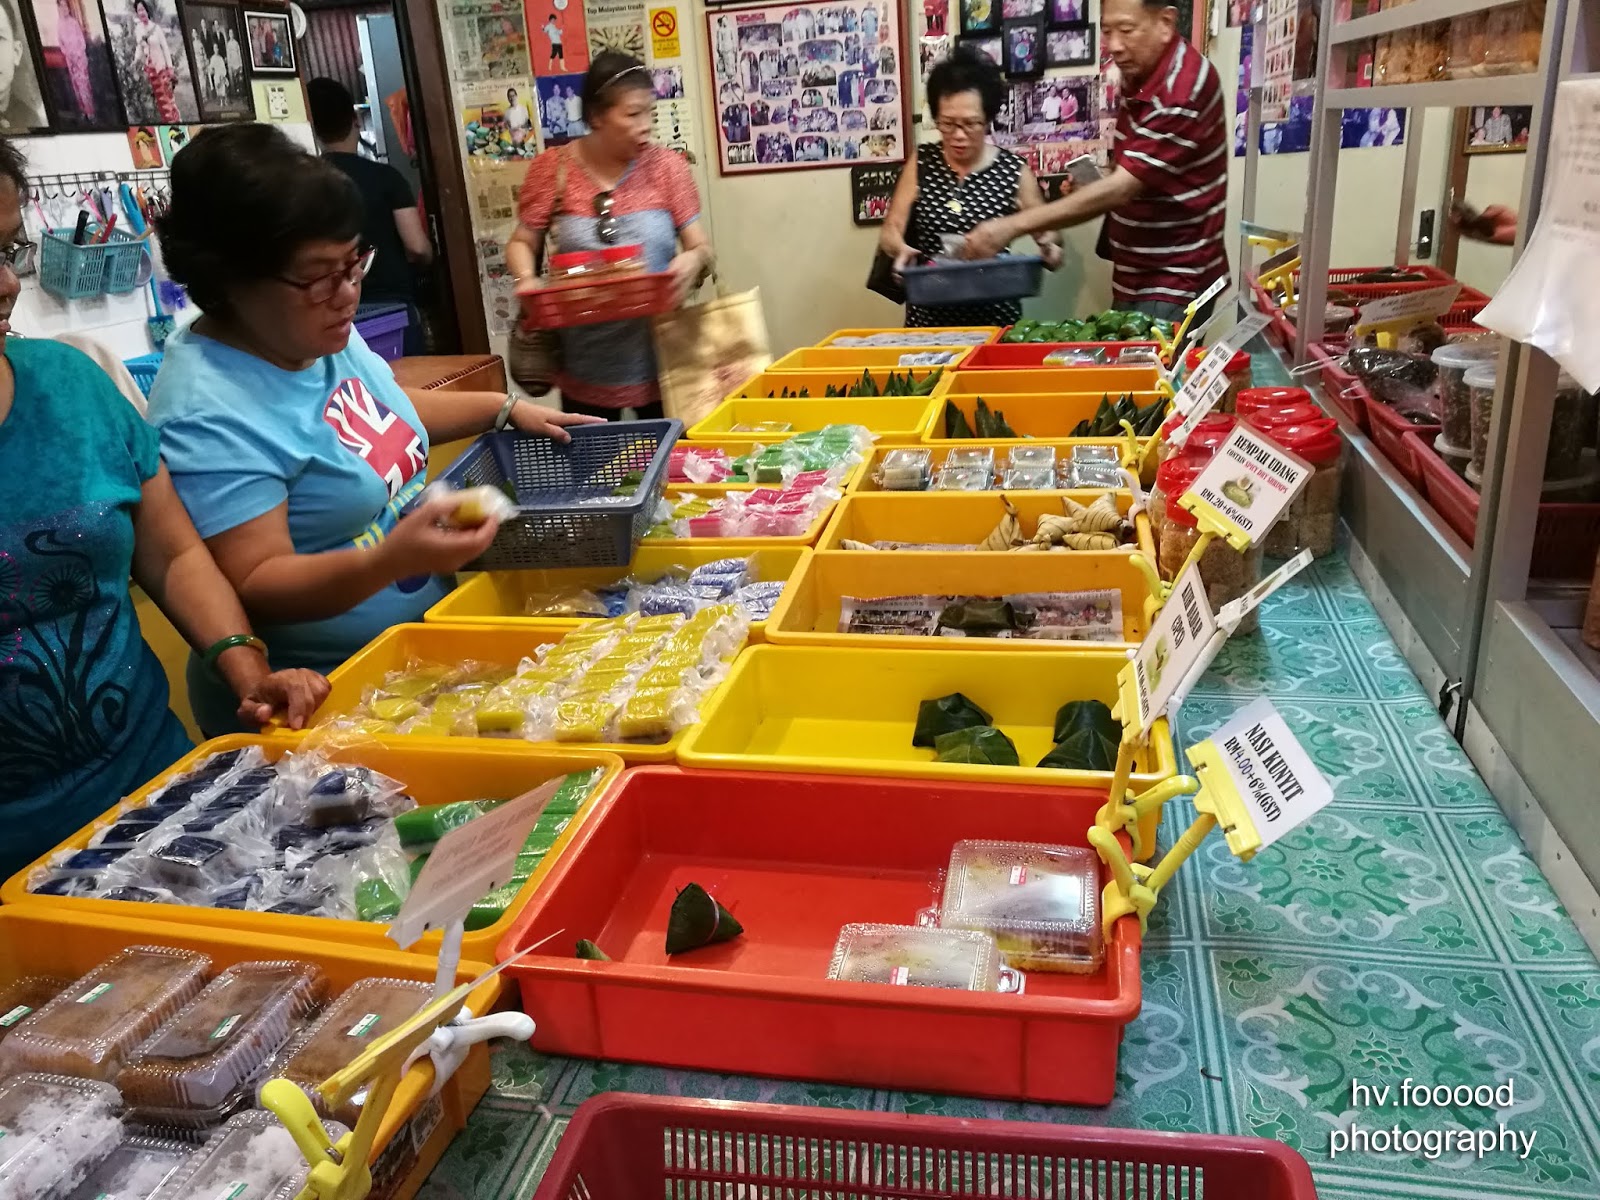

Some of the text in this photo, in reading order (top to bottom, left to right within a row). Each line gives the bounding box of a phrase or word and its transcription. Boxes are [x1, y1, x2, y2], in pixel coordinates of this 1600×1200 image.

[598, 5, 626, 13] Malaysian
[1226, 448, 1246, 465] CONTAIN
[1243, 460, 1260, 475] SPICY
[1233, 435, 1299, 484] REMPAH UDANG
[1200, 487, 1254, 531] RM1.20+6%(GST)
[1186, 600, 1203, 640] DADAR
[1224, 735, 1283, 823] RM4.00+6%(GST)
[1244, 722, 1305, 803] NASI KUNYIT
